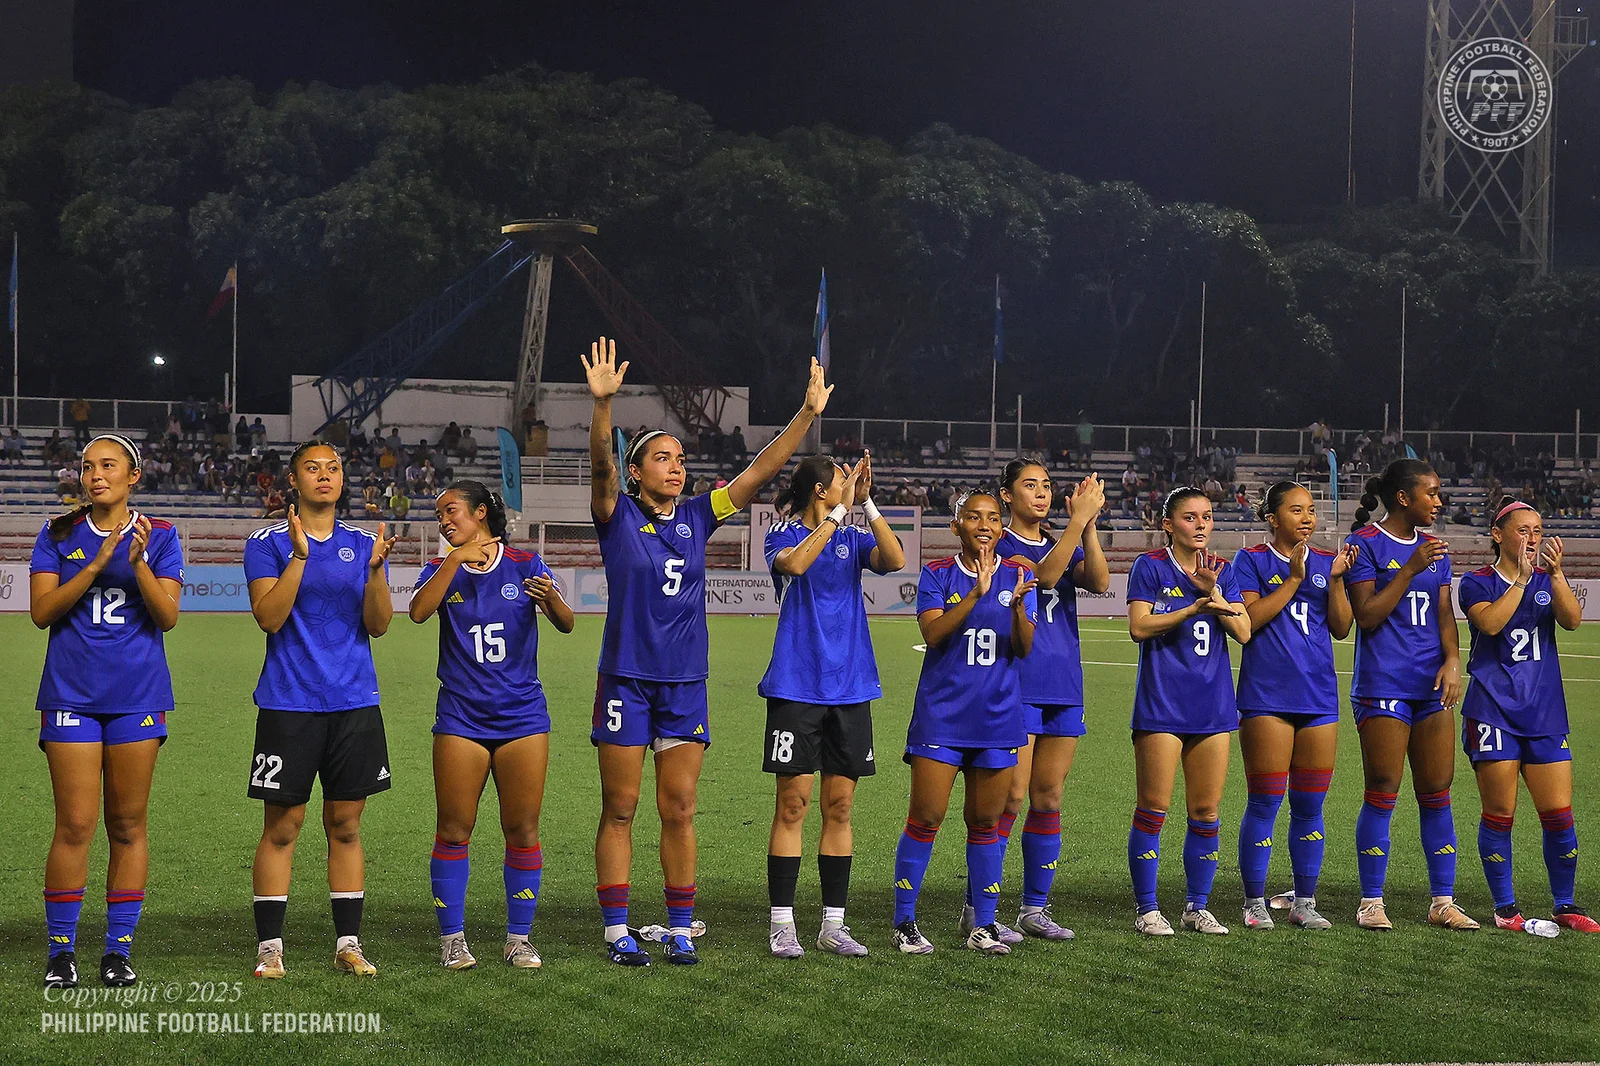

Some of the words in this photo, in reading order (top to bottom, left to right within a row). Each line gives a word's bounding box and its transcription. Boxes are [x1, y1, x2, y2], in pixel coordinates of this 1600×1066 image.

[662, 558, 685, 596] 5
[706, 579, 771, 588] NTERNATIONAL
[901, 586, 916, 595] UFA
[89, 587, 126, 624] 12
[706, 589, 743, 604] INES
[753, 593, 765, 602] VS
[1042, 588, 1060, 623] 7
[1406, 591, 1431, 626] 17
[1290, 602, 1310, 635] 4
[468, 622, 507, 663] 15
[963, 628, 997, 666] 19
[1193, 620, 1210, 656] 9
[1510, 626, 1541, 662] 21
[606, 699, 623, 732] 5
[771, 729, 795, 763] 18
[1478, 723, 1503, 752] 21
[251, 753, 283, 789] 22
